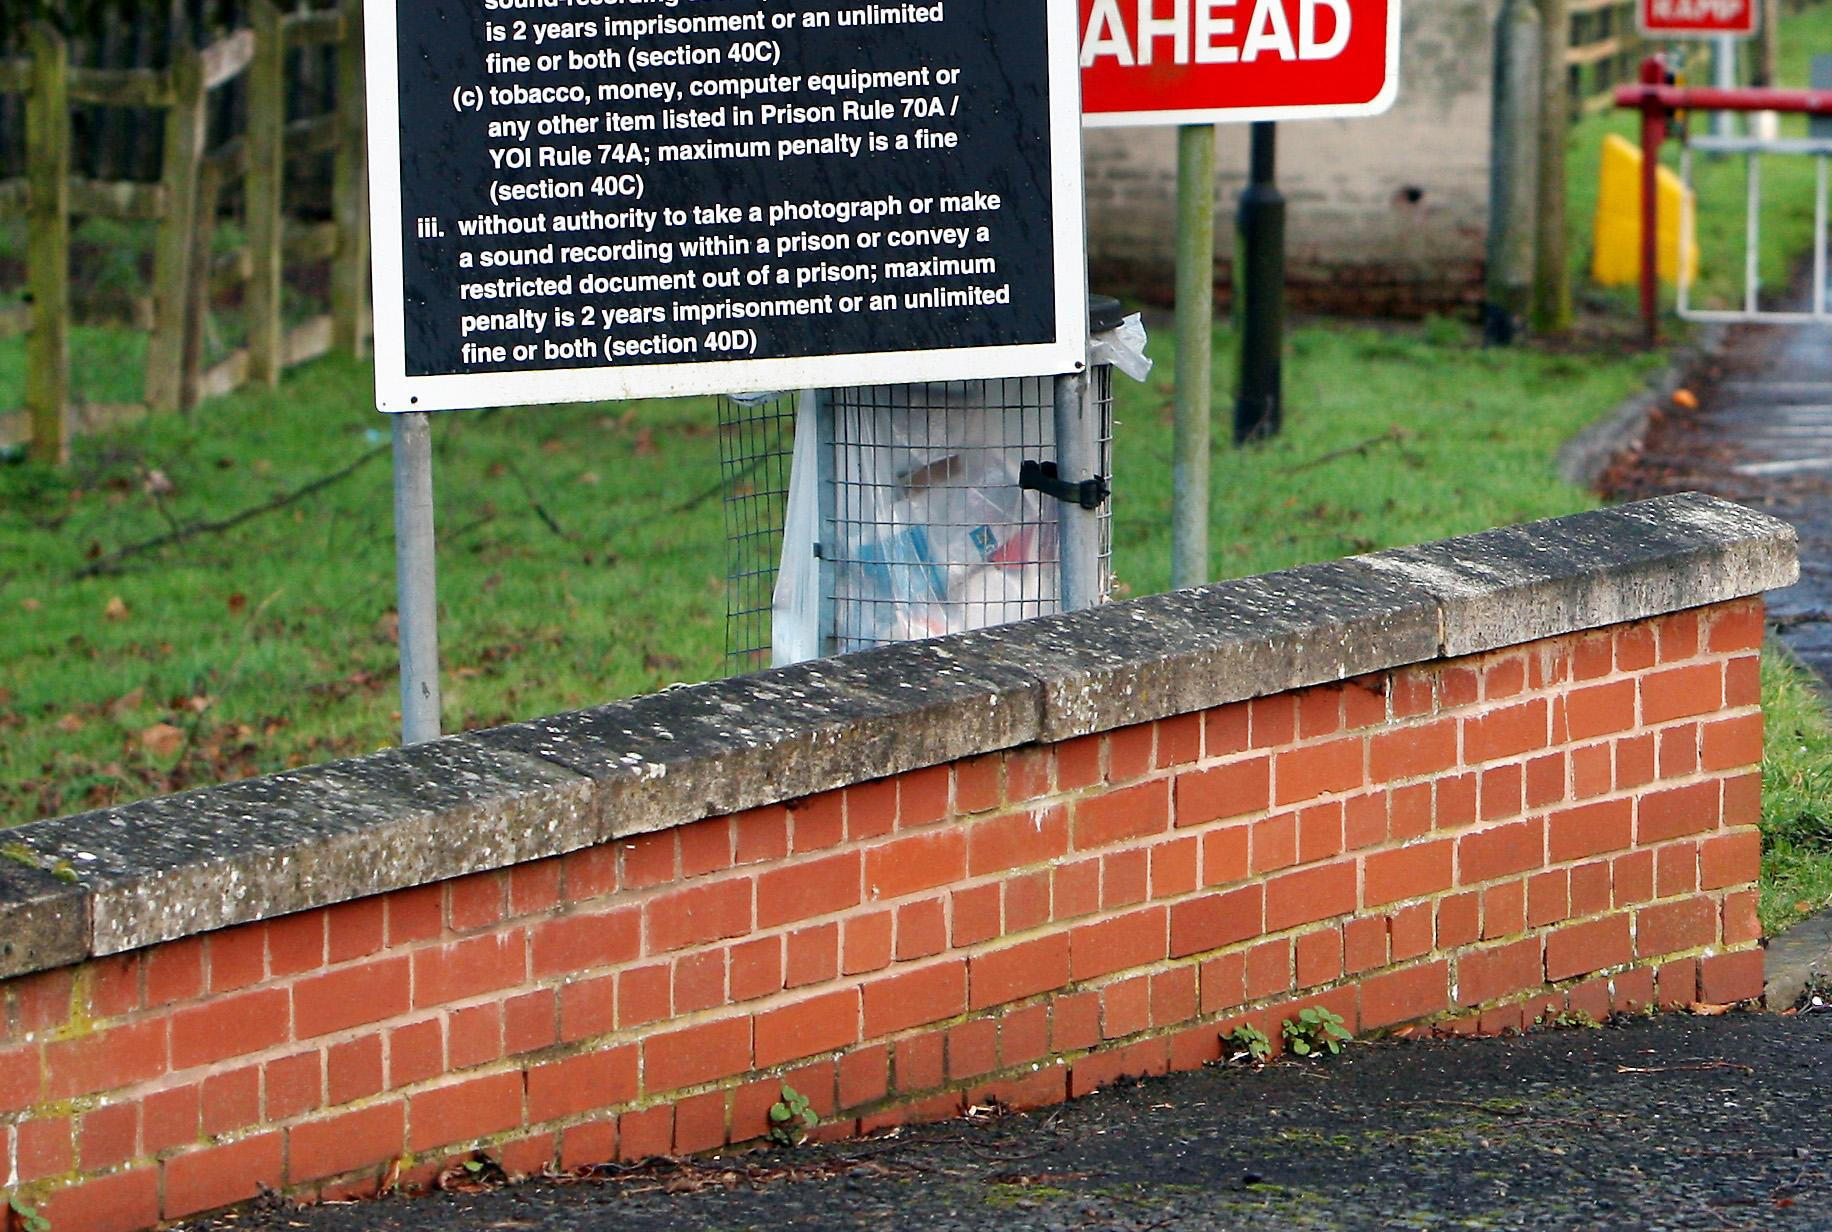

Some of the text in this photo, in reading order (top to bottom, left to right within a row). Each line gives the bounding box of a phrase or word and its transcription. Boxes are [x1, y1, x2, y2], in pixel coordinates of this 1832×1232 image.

[453, 66, 960, 112] (c) tobacco, money, computer equipment or
[488, 120, 531, 141] any
[537, 113, 599, 135] other
[605, 111, 655, 132] item
[662, 106, 725, 129] listed
[732, 106, 753, 126] in
[761, 103, 835, 124] Prison
[842, 99, 894, 121] Rule
[900, 96, 945, 118] 70A
[488, 128, 958, 169] YOI Rule 74A; maximum penalty is a fine
[417, 190, 1001, 238] iii. without authority to take a photograph or make
[460, 256, 995, 300] restricted document out of a prison; maximum
